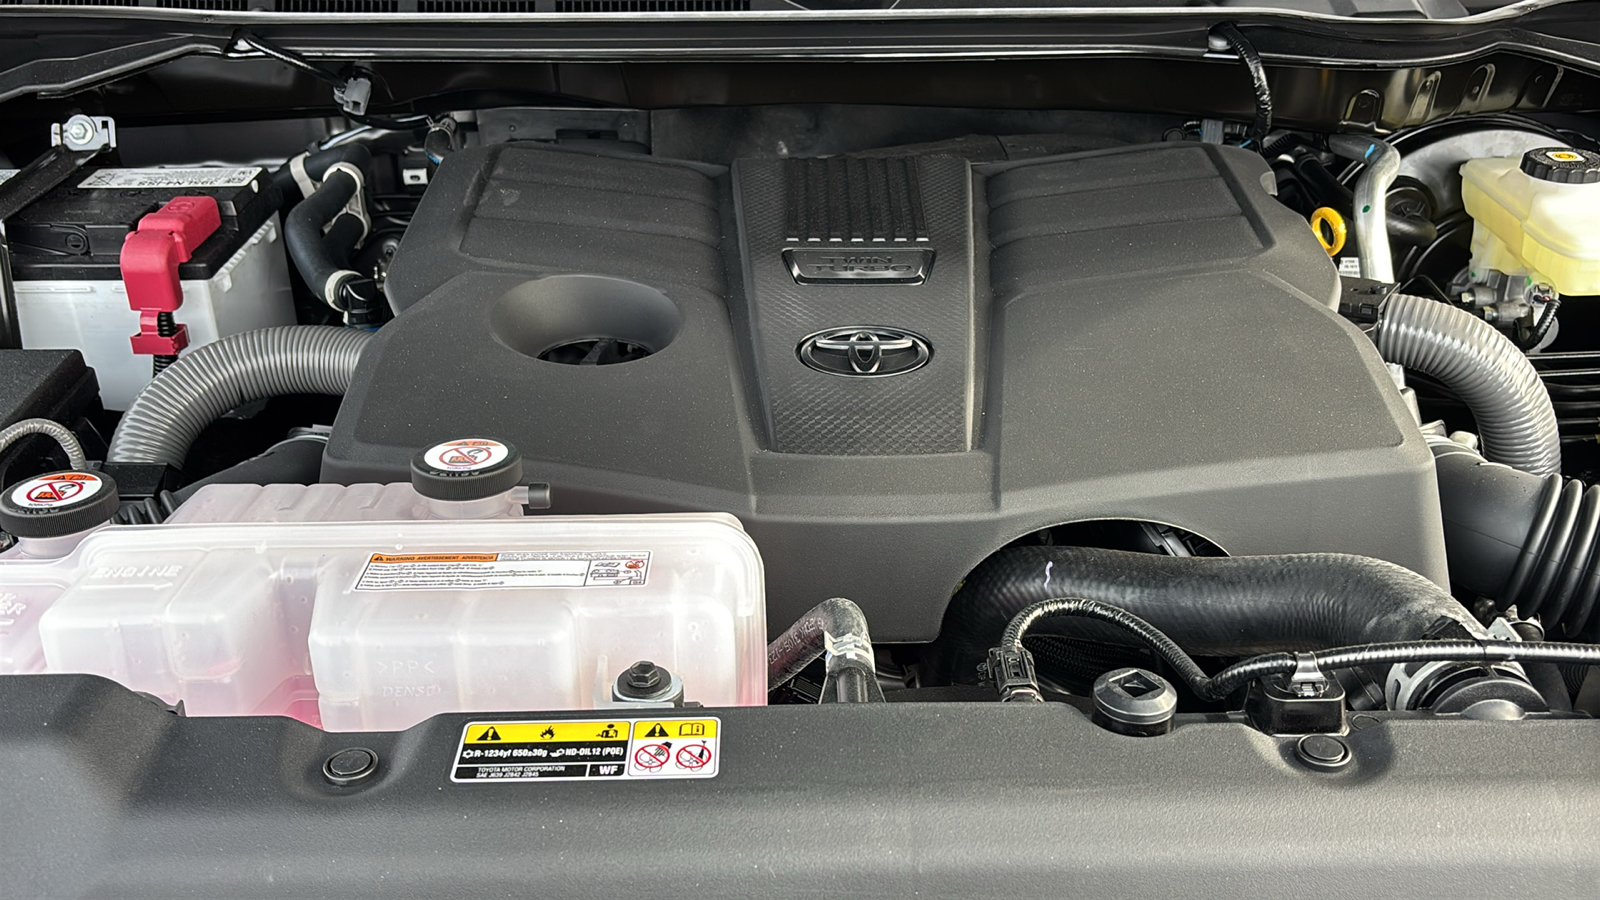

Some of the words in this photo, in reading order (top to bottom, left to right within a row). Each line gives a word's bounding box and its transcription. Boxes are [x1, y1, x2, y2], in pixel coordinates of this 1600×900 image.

[820, 256, 893, 264] TWIN
[806, 263, 912, 272] TURBO
[90, 565, 183, 579] ENGINE
[474, 749, 512, 758] R-1234yf
[565, 747, 601, 756] ND-OIL12
[602, 747, 624, 756] (POE)
[599, 766, 619, 775] WF
